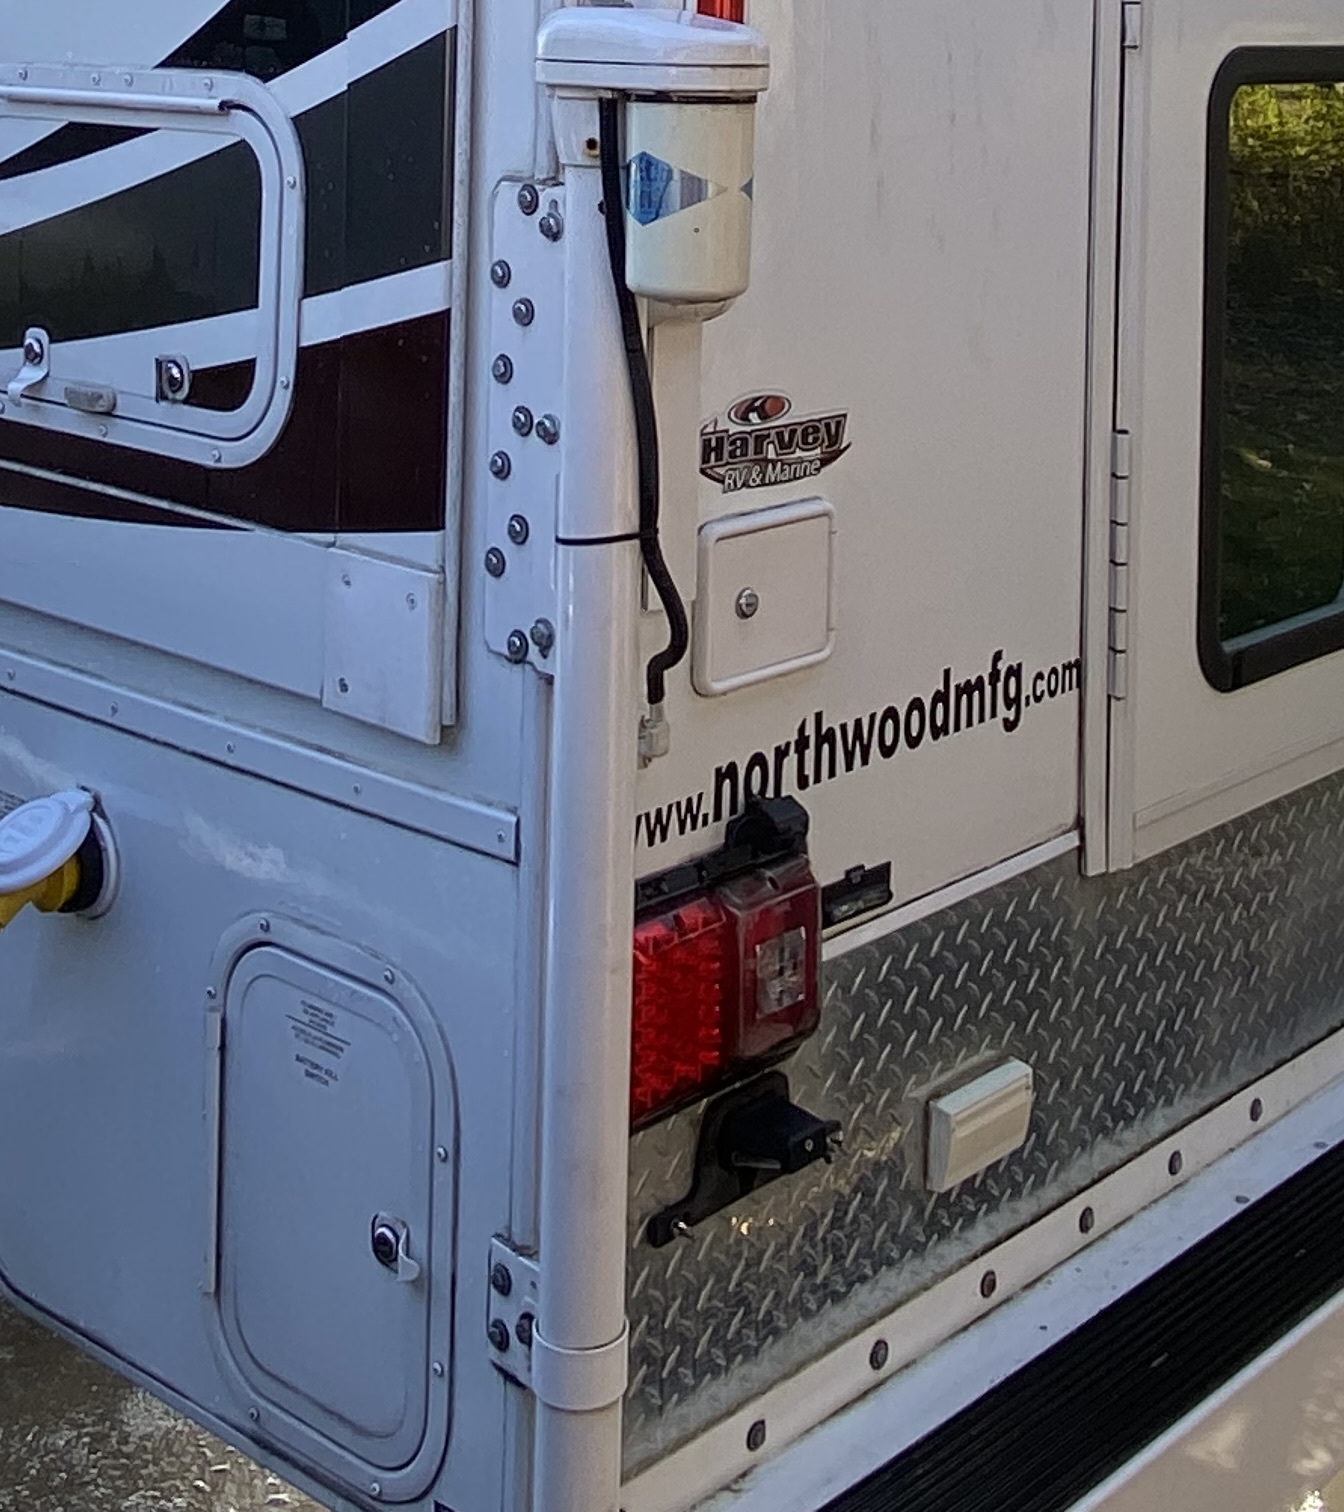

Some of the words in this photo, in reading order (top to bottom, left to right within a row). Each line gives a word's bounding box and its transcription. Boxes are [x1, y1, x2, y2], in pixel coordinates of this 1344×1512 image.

[700, 414, 847, 466] Harvey
[723, 465, 749, 491] RV
[749, 464, 763, 487] &
[765, 458, 821, 485] Marine
[635, 649, 1081, 848] ww.northwoodmfg.com
